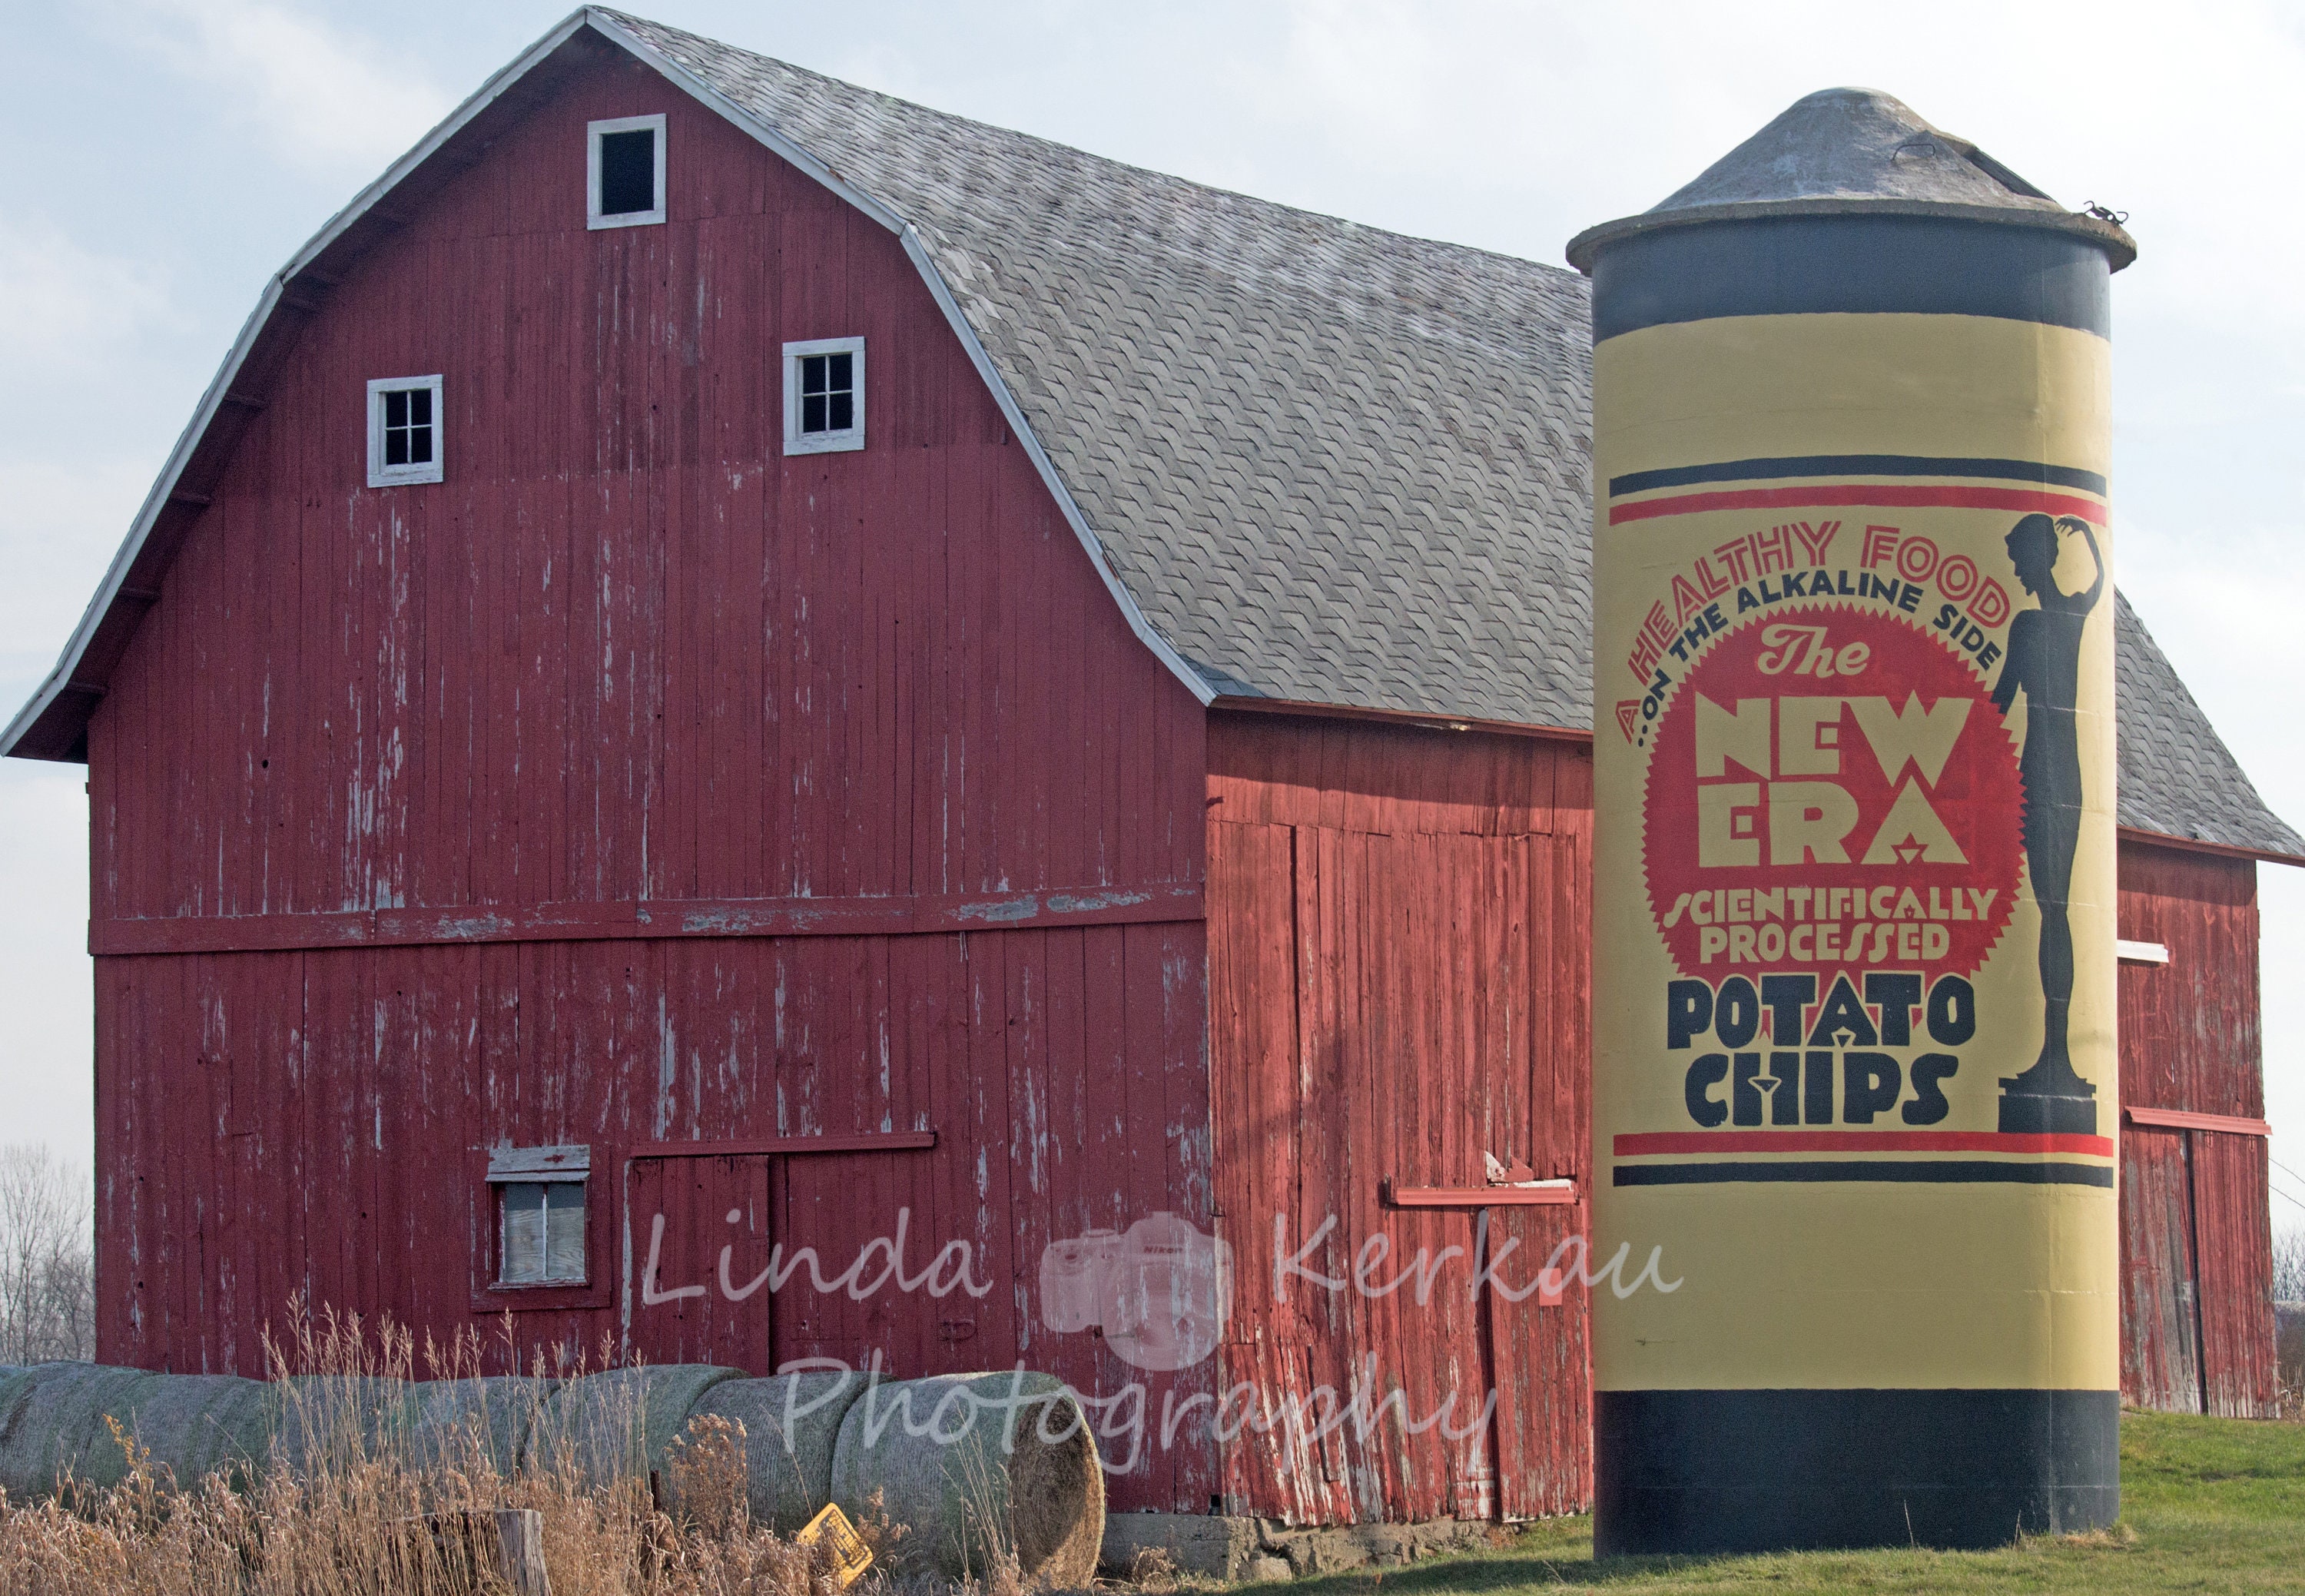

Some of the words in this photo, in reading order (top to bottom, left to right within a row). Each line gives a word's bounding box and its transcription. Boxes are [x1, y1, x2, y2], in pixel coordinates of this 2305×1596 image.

[1616, 699, 1640, 744] A
[1628, 521, 1842, 686] HEALTHY
[1862, 525, 2011, 629] FOOD
[1669, 602, 1729, 662] THE
[1737, 570, 1924, 614] ALKALINE
[1933, 604, 2002, 671] SIDE
[1757, 623, 1870, 678] The
[1695, 691, 1974, 789] NEW
[1698, 775, 1969, 868] ERA
[1663, 886, 1999, 927] SCIENTIFICALLY
[1700, 923, 1950, 964] PROCESSED
[1667, 974, 1975, 1049] POTATO
[1685, 1052, 1958, 1126] CHIPS
